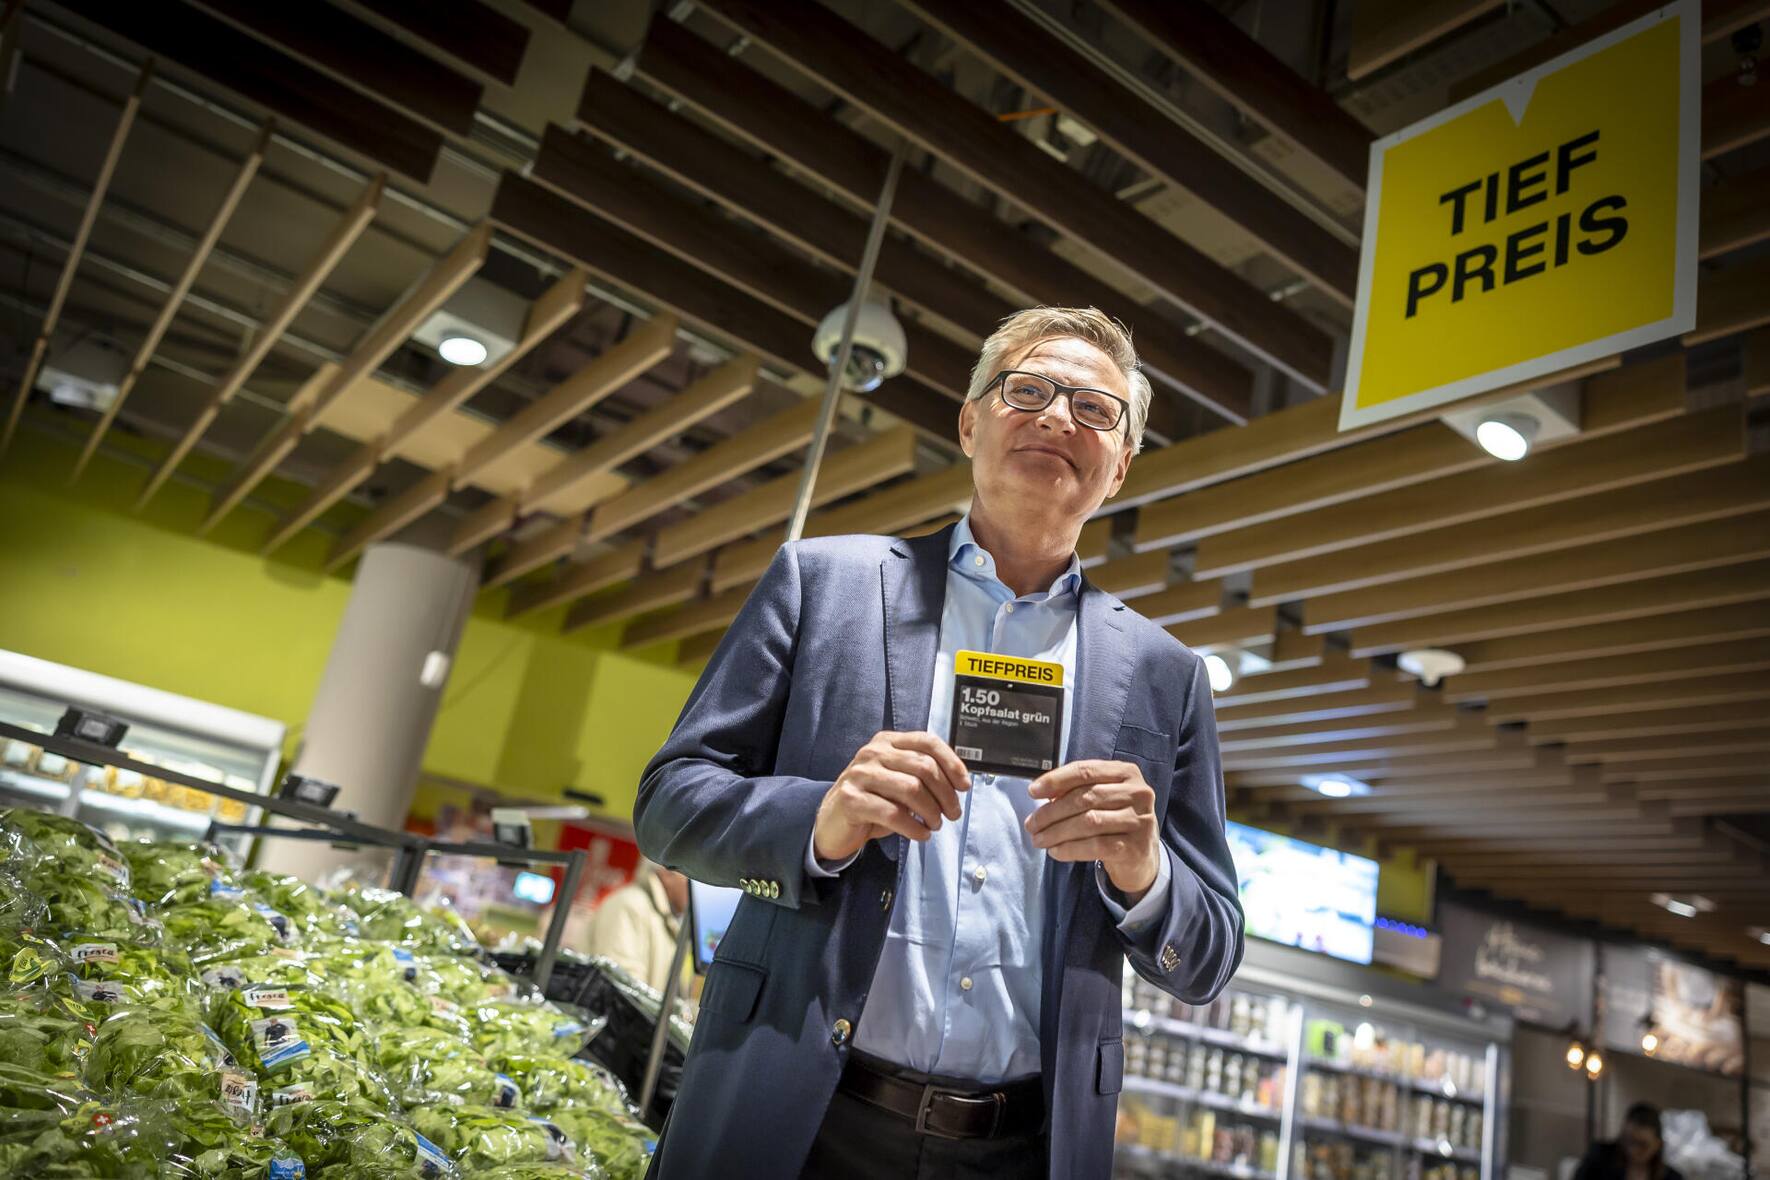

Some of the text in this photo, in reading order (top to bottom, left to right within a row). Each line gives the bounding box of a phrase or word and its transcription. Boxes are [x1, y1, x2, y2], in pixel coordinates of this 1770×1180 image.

[1439, 129, 1600, 236] TIEF
[1405, 195, 1628, 320] PREIS
[967, 658, 1054, 681] TIEFPREIS
[962, 687, 1001, 706] 1.50
[960, 703, 1020, 720] Kopfsalat
[1022, 712, 1050, 724] grün
